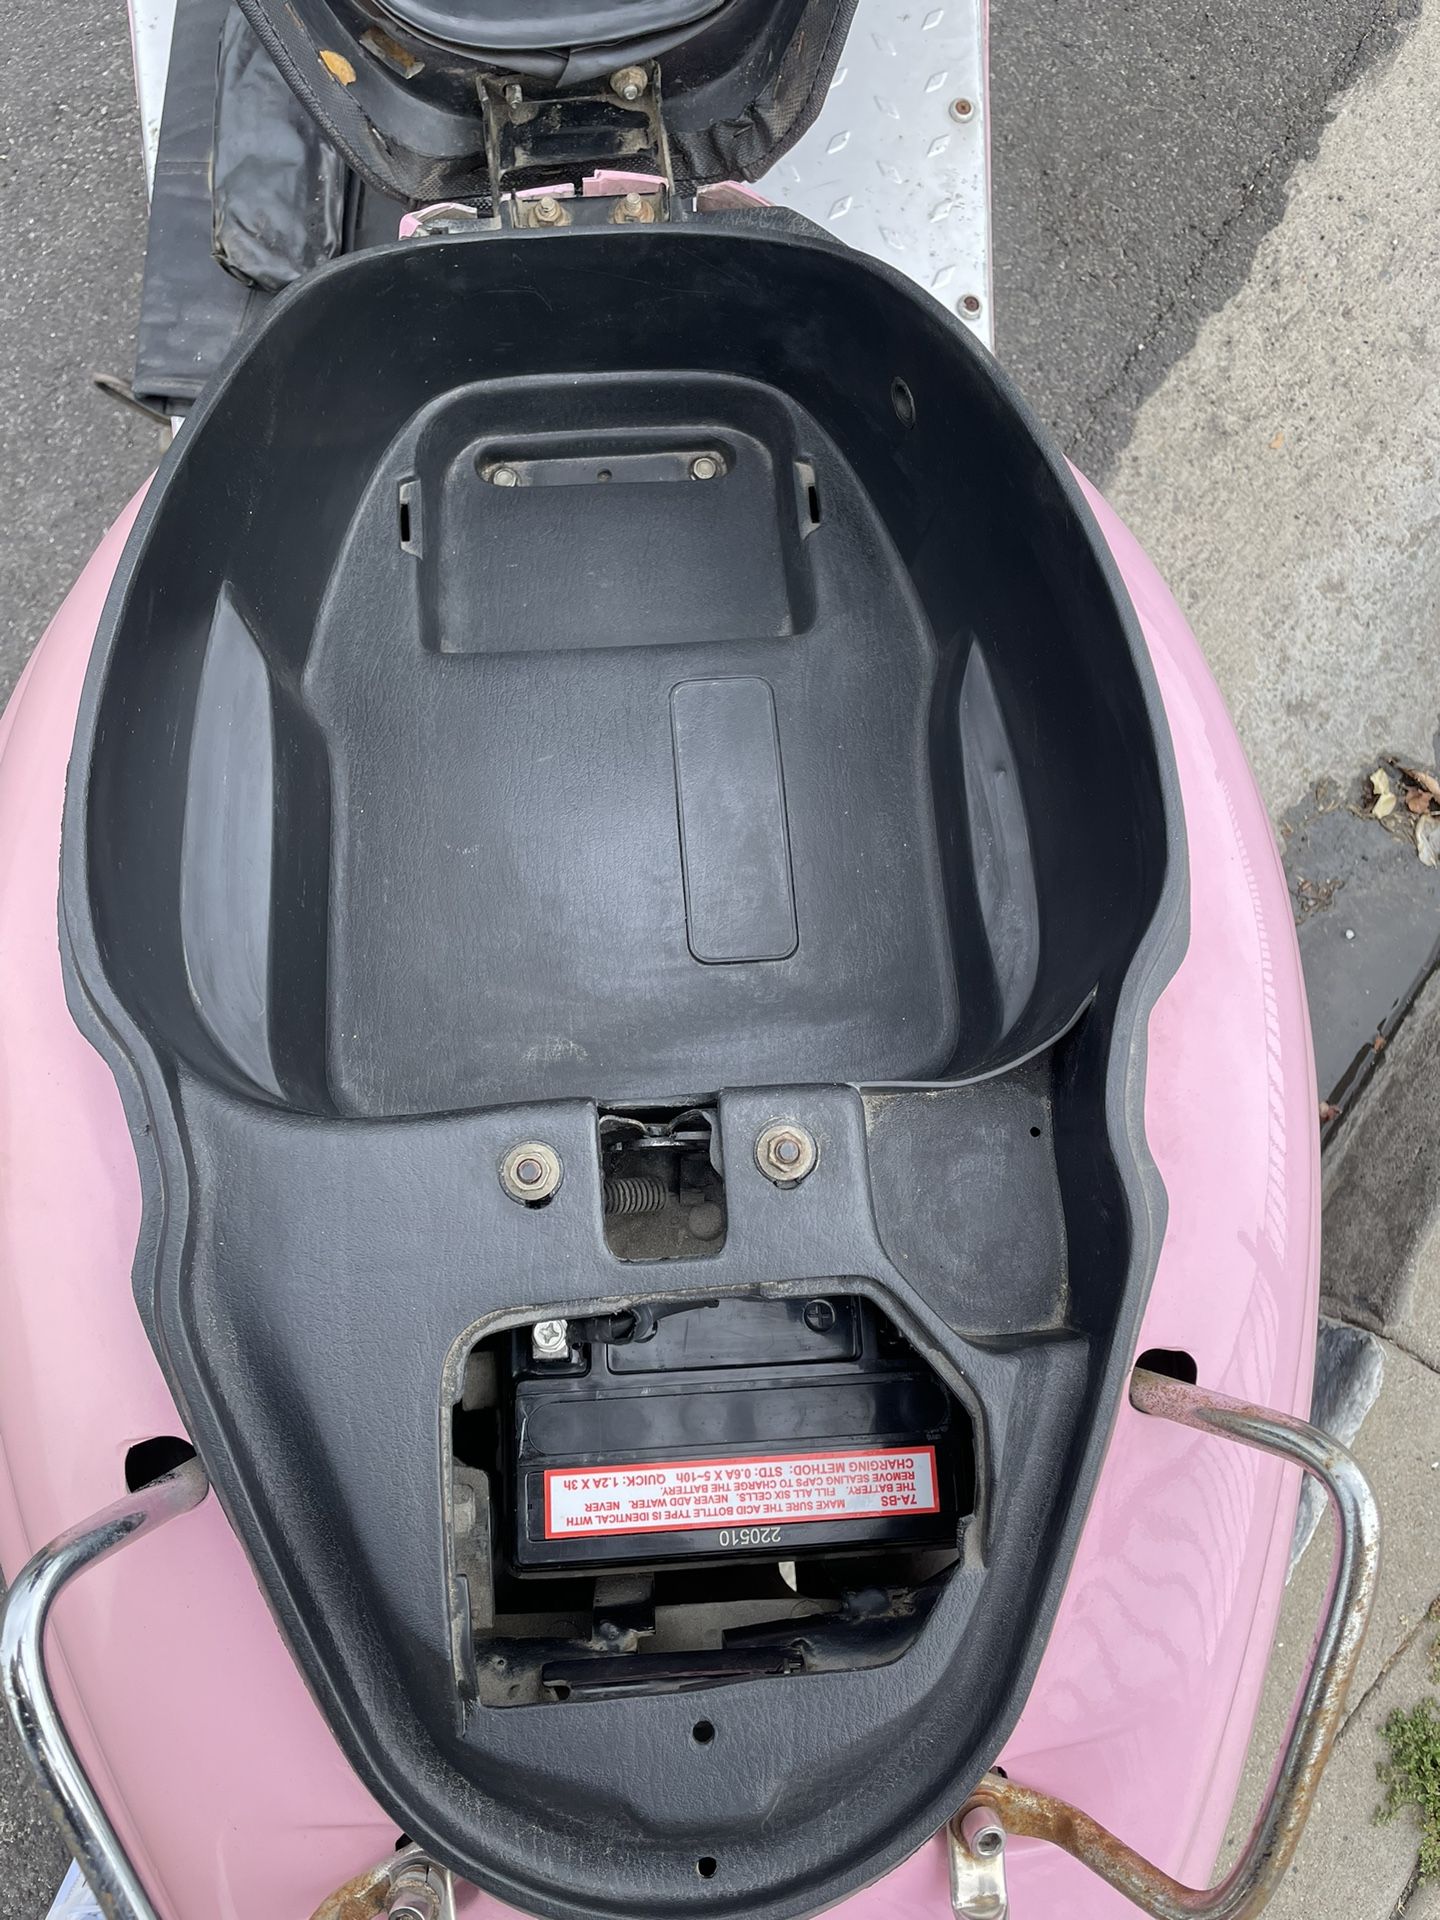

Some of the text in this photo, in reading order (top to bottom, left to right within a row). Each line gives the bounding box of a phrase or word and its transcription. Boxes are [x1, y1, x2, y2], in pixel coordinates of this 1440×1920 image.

[564, 1458, 913, 1491] CHARGING METHOD: STD: 0.6A X 5~10h QUICK: 1.2A X 3h
[661, 1471, 915, 1495] REMOVE SEALING CAPS TO CHARGE THE BATTERY.
[566, 1494, 917, 1526] 7A-BS MAKE SURE THE ACID BOTTLE TYPE IS IDENTICAL WITH
[585, 1482, 915, 1512] THE BATTERY. FILL ALL SIX CELLS. NEVER ADD WATER. NEVER
[719, 1527, 781, 1546] 220510
